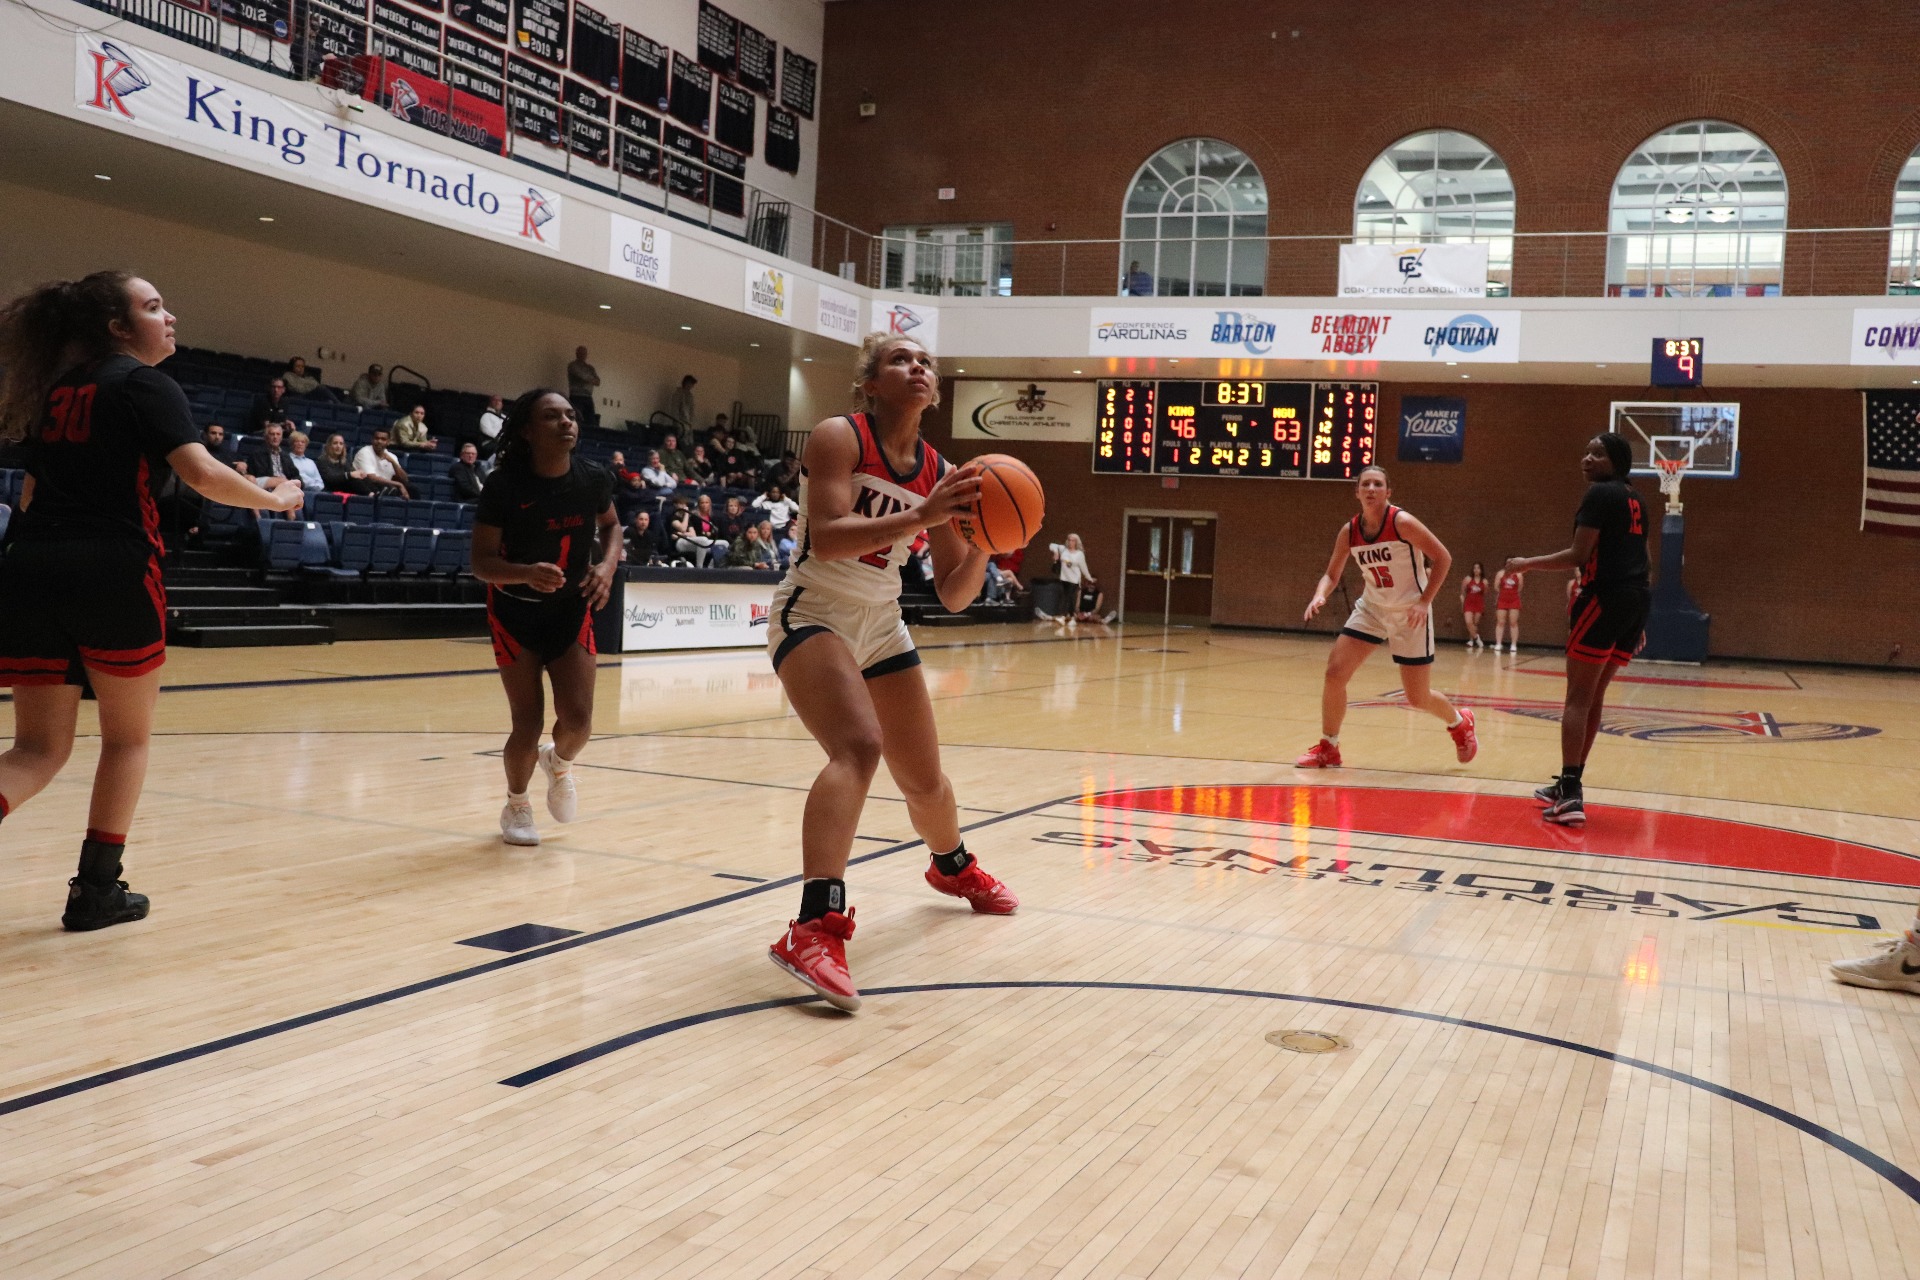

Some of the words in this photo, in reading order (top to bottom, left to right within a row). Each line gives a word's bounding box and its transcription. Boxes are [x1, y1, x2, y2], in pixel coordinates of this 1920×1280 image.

[531, 37, 551, 57] 2019
[422, 105, 488, 146] TORNADO
[186, 76, 308, 164] King
[324, 122, 499, 215] Tornado
[623, 244, 659, 270] Citizens
[635, 267, 658, 284] BANK
[1344, 286, 1414, 295] CONERENCE
[1418, 286, 1481, 295] CAROLINAS
[1311, 315, 1392, 335] BELMONT
[1098, 327, 1188, 342] CAROLINAS
[1210, 324, 1276, 343] BARTON
[1424, 326, 1499, 346] CHOWAN
[1864, 326, 1920, 348] CONV
[1322, 335, 1378, 354] ABBEY
[1665, 340, 1700, 357] 8:37
[1678, 356, 1694, 380] 9
[1107, 388, 1116, 401] 2
[1126, 388, 1134, 401] 2
[1148, 390, 1153, 401] 1
[1218, 382, 1263, 404] 8:37
[1328, 392, 1334, 404] 1
[1345, 391, 1354, 405] 2
[1361, 393, 1375, 404] 11
[42, 384, 97, 443] 30
[1106, 402, 1115, 415] 5
[1128, 404, 1133, 414] 1
[1145, 403, 1152, 414] 7
[1168, 406, 1195, 417] KING
[1324, 407, 1333, 418] 4
[1348, 407, 1353, 419] 1
[1365, 407, 1374, 420] 0
[1424, 410, 1449, 418] MAKE
[1101, 417, 1114, 428] 11
[1124, 417, 1133, 430] 0
[1144, 417, 1152, 429] 7
[1170, 418, 1196, 439] 46
[1226, 422, 1238, 437] 4
[1319, 420, 1332, 434] 12
[1347, 422, 1352, 433] 1
[1364, 423, 1373, 434] 4
[1404, 411, 1458, 437] YOURS
[1101, 430, 1114, 443] 12
[1123, 431, 1132, 444] 0
[1142, 431, 1151, 444] 0
[1274, 420, 1301, 441] 63
[1314, 435, 1332, 449] 24
[1343, 436, 1352, 449] 2
[1359, 436, 1372, 449] 19
[1100, 445, 1113, 457] 15
[1126, 446, 1132, 457] 1
[1142, 446, 1151, 457] 4
[1173, 448, 1179, 463] 1
[1190, 448, 1201, 465] 2
[1212, 448, 1233, 465] 24
[1238, 449, 1249, 466] 2
[1314, 449, 1331, 463] 30
[1342, 450, 1351, 464] 0
[1362, 451, 1371, 464] 2
[1125, 460, 1131, 471] 1
[1261, 450, 1272, 467] 3
[1294, 451, 1299, 466] 1
[1345, 466, 1350, 478] 1
[852, 485, 912, 518] KIN
[1628, 497, 1643, 535] 12
[556, 535, 571, 569] 1
[1358, 547, 1392, 565] KING
[1368, 566, 1394, 588] 15
[625, 605, 664, 628] Aubrey's
[666, 606, 704, 615] COURTYARD
[709, 604, 736, 620] HMG
[1031, 831, 1881, 931] CAROLINAS
[1118, 853, 1680, 918] CONFERENCE
